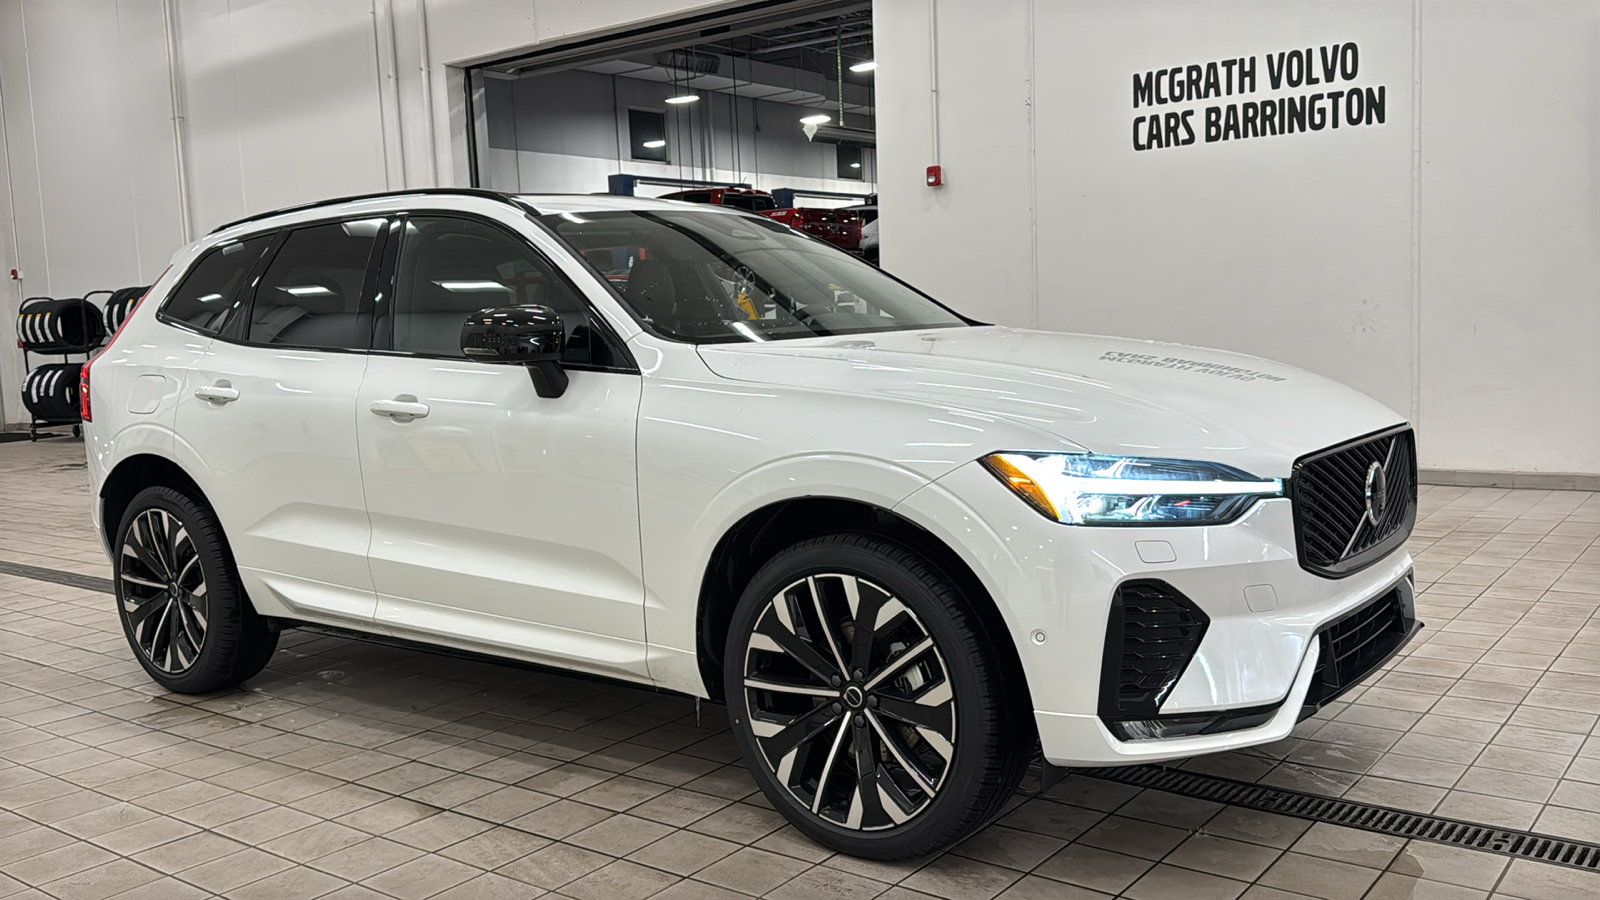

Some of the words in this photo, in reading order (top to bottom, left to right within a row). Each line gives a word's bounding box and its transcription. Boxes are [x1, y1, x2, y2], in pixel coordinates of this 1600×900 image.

[1132, 56, 1256, 109] MCGRATH
[1266, 42, 1359, 90] VOLVO
[1132, 109, 1196, 152] CARS
[1205, 85, 1386, 143] BARRINGTON
